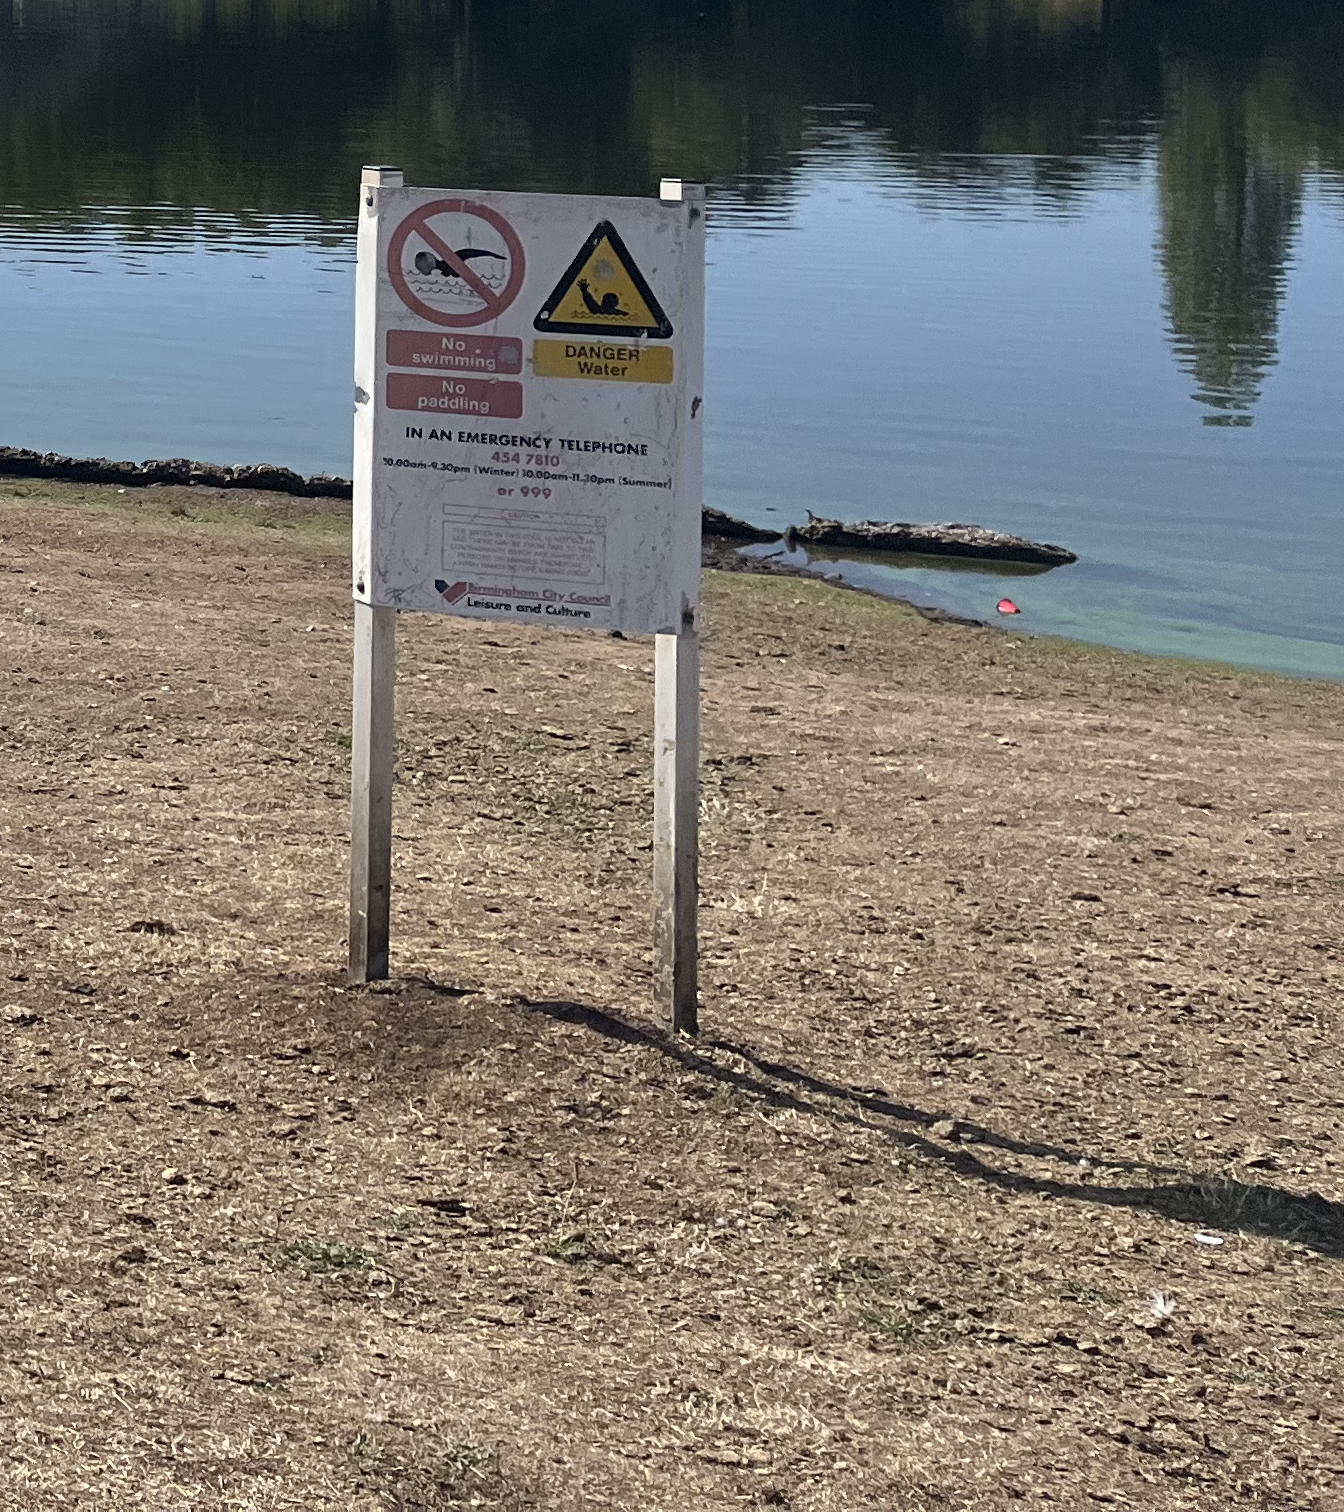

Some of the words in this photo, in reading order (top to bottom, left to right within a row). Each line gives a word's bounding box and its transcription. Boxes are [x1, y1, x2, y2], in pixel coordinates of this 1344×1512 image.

[442, 337, 466, 352] No
[564, 345, 640, 361] DANGER
[412, 352, 496, 371] swimming
[577, 361, 629, 377] Water
[442, 380, 466, 395] No
[417, 396, 490, 414] paddling
[405, 427, 424, 439] IN
[428, 428, 453, 442] AN
[457, 431, 553, 449] EMERGENCY
[559, 438, 649, 456] TELEPHONE
[491, 451, 521, 465] 454
[525, 453, 560, 467] 7810
[473, 465, 519, 478] (Winter)
[618, 475, 672, 490] (Summer)
[497, 487, 515, 496] or
[520, 486, 552, 500] 999
[468, 582, 539, 598] Birmingham
[542, 589, 565, 603] City
[567, 592, 611, 605] Council
[467, 597, 512, 611] Leisure
[515, 602, 542, 614] and
[545, 604, 591, 619] Culture
